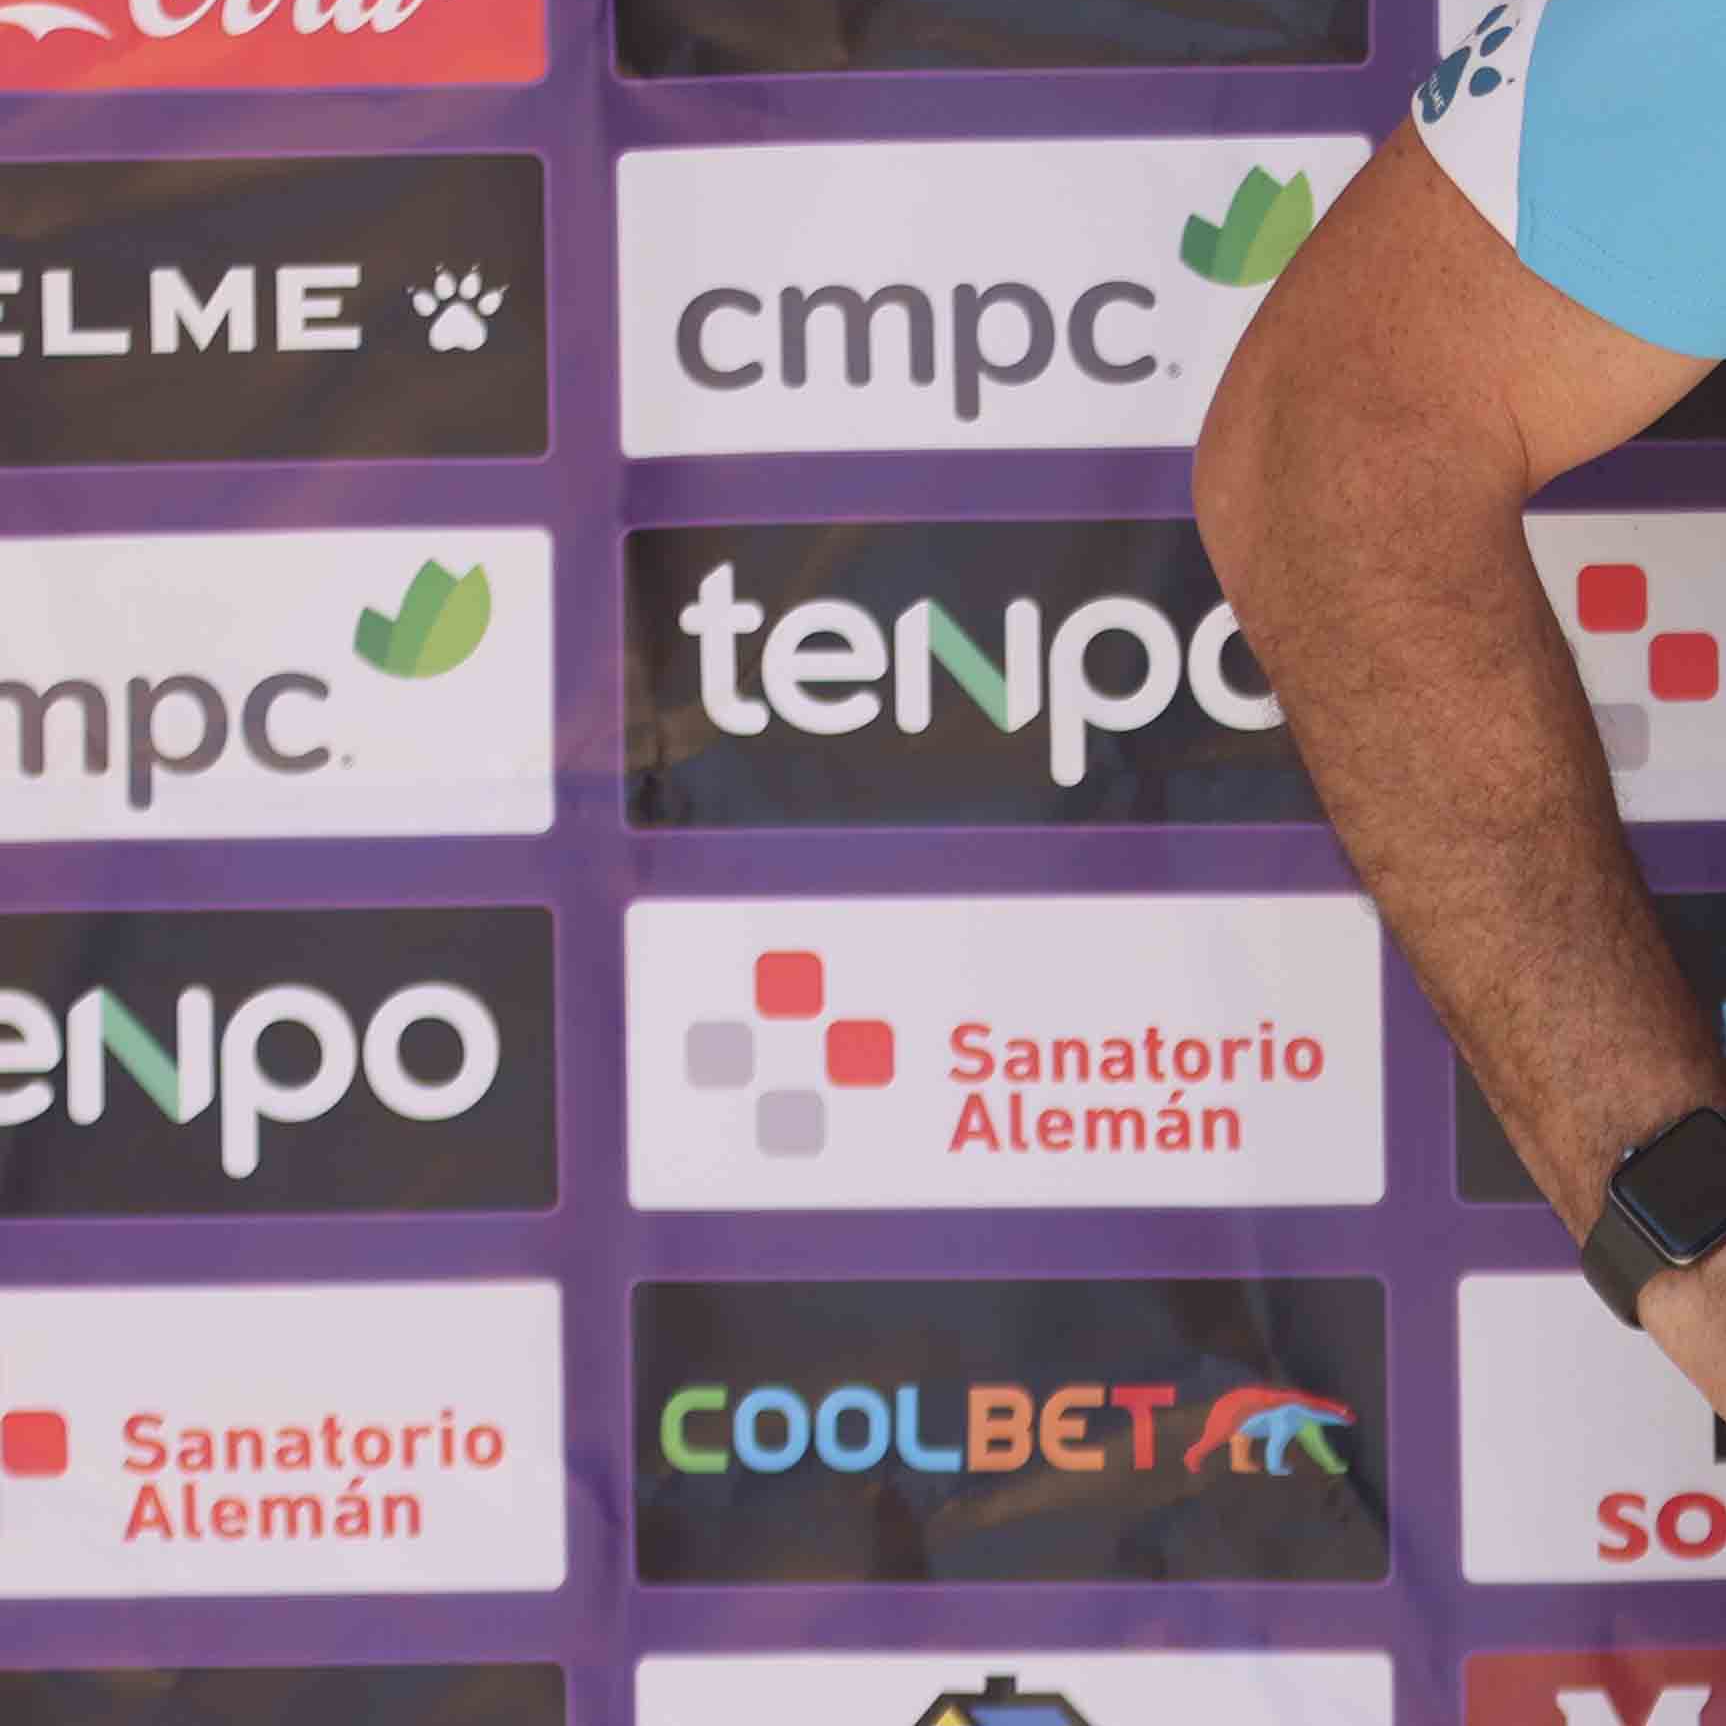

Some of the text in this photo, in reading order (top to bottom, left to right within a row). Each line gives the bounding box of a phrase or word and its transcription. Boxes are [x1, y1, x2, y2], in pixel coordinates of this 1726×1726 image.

[0, 265, 361, 357] LME
[948, 1021, 1325, 1083] Sanatorio
[948, 1091, 1243, 1153] Alemán
[123, 1410, 505, 1473] Sanatorio
[661, 1385, 1174, 1473] COOLBET
[123, 1477, 423, 1543] Alemán
